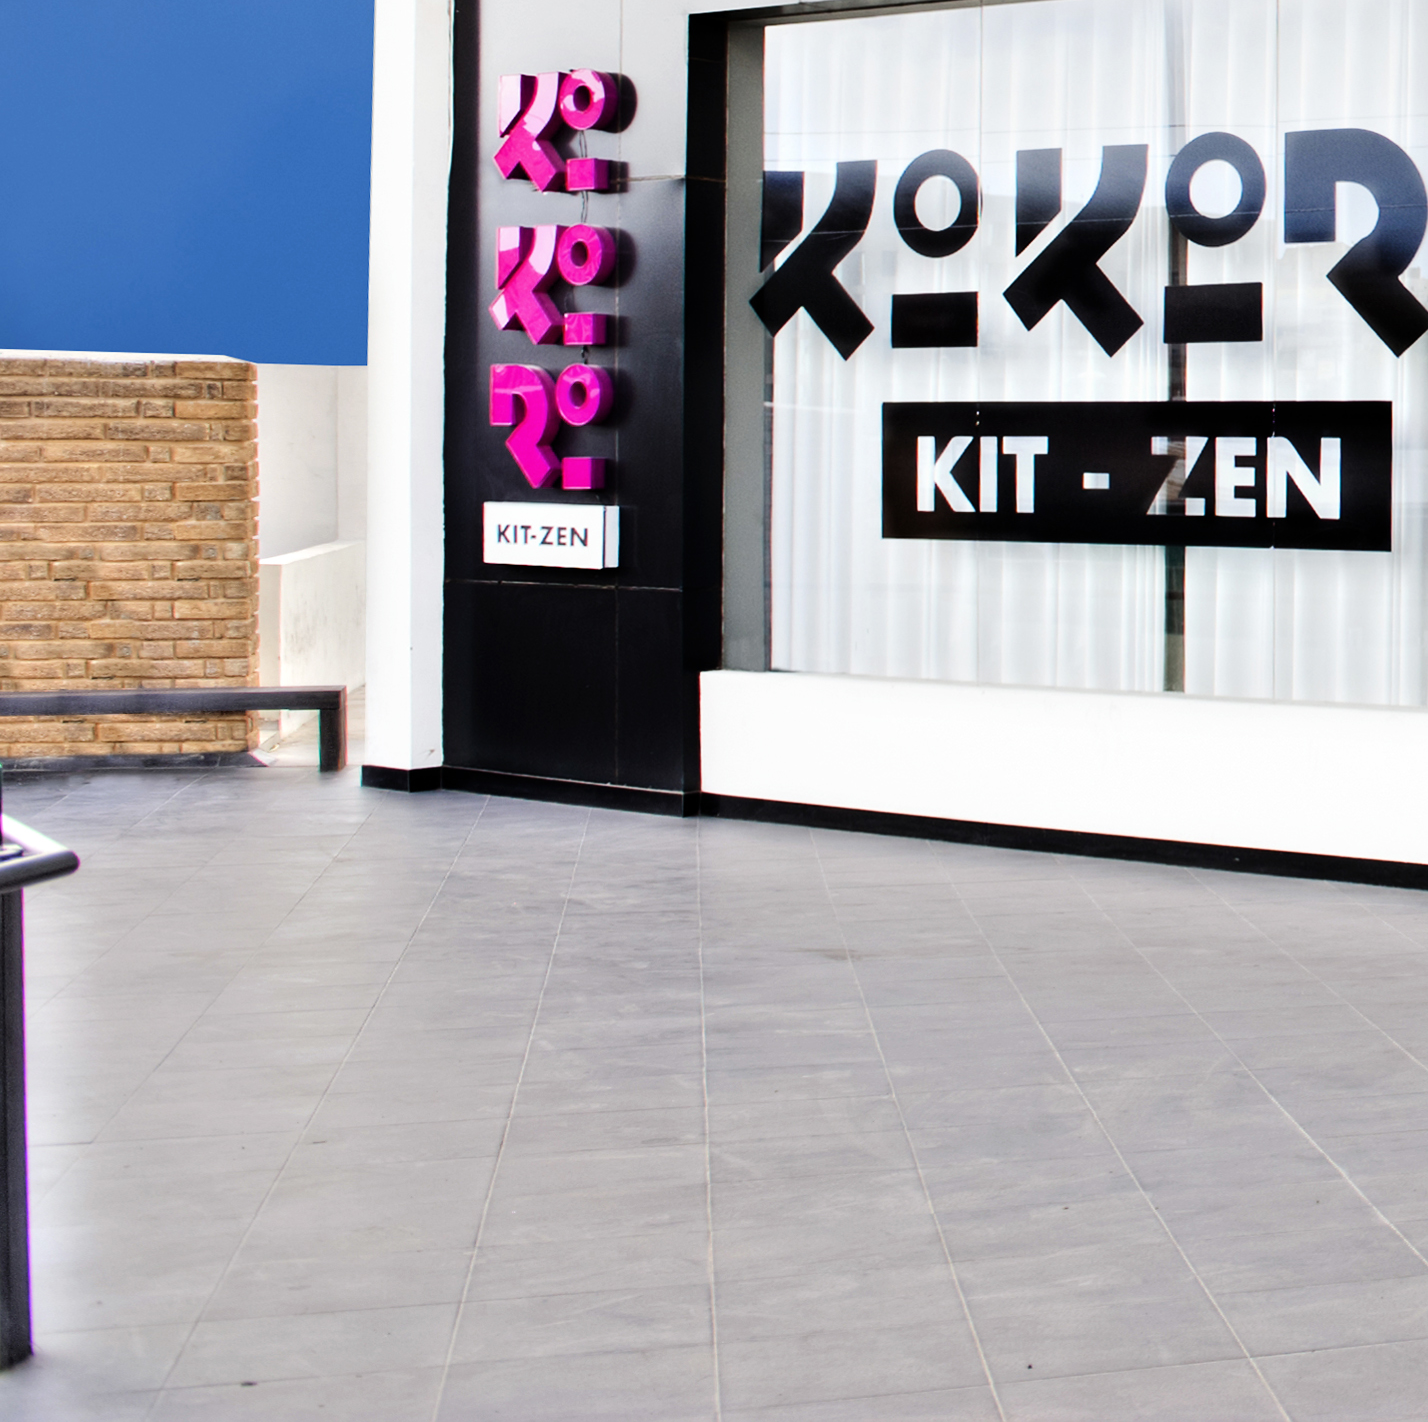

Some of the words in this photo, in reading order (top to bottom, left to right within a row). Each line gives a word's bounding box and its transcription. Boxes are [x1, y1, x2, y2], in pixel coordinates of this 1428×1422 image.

[916, 435, 1049, 514] KIT
[1146, 435, 1342, 520] ZEN
[496, 523, 589, 548] KIT-ZEN
